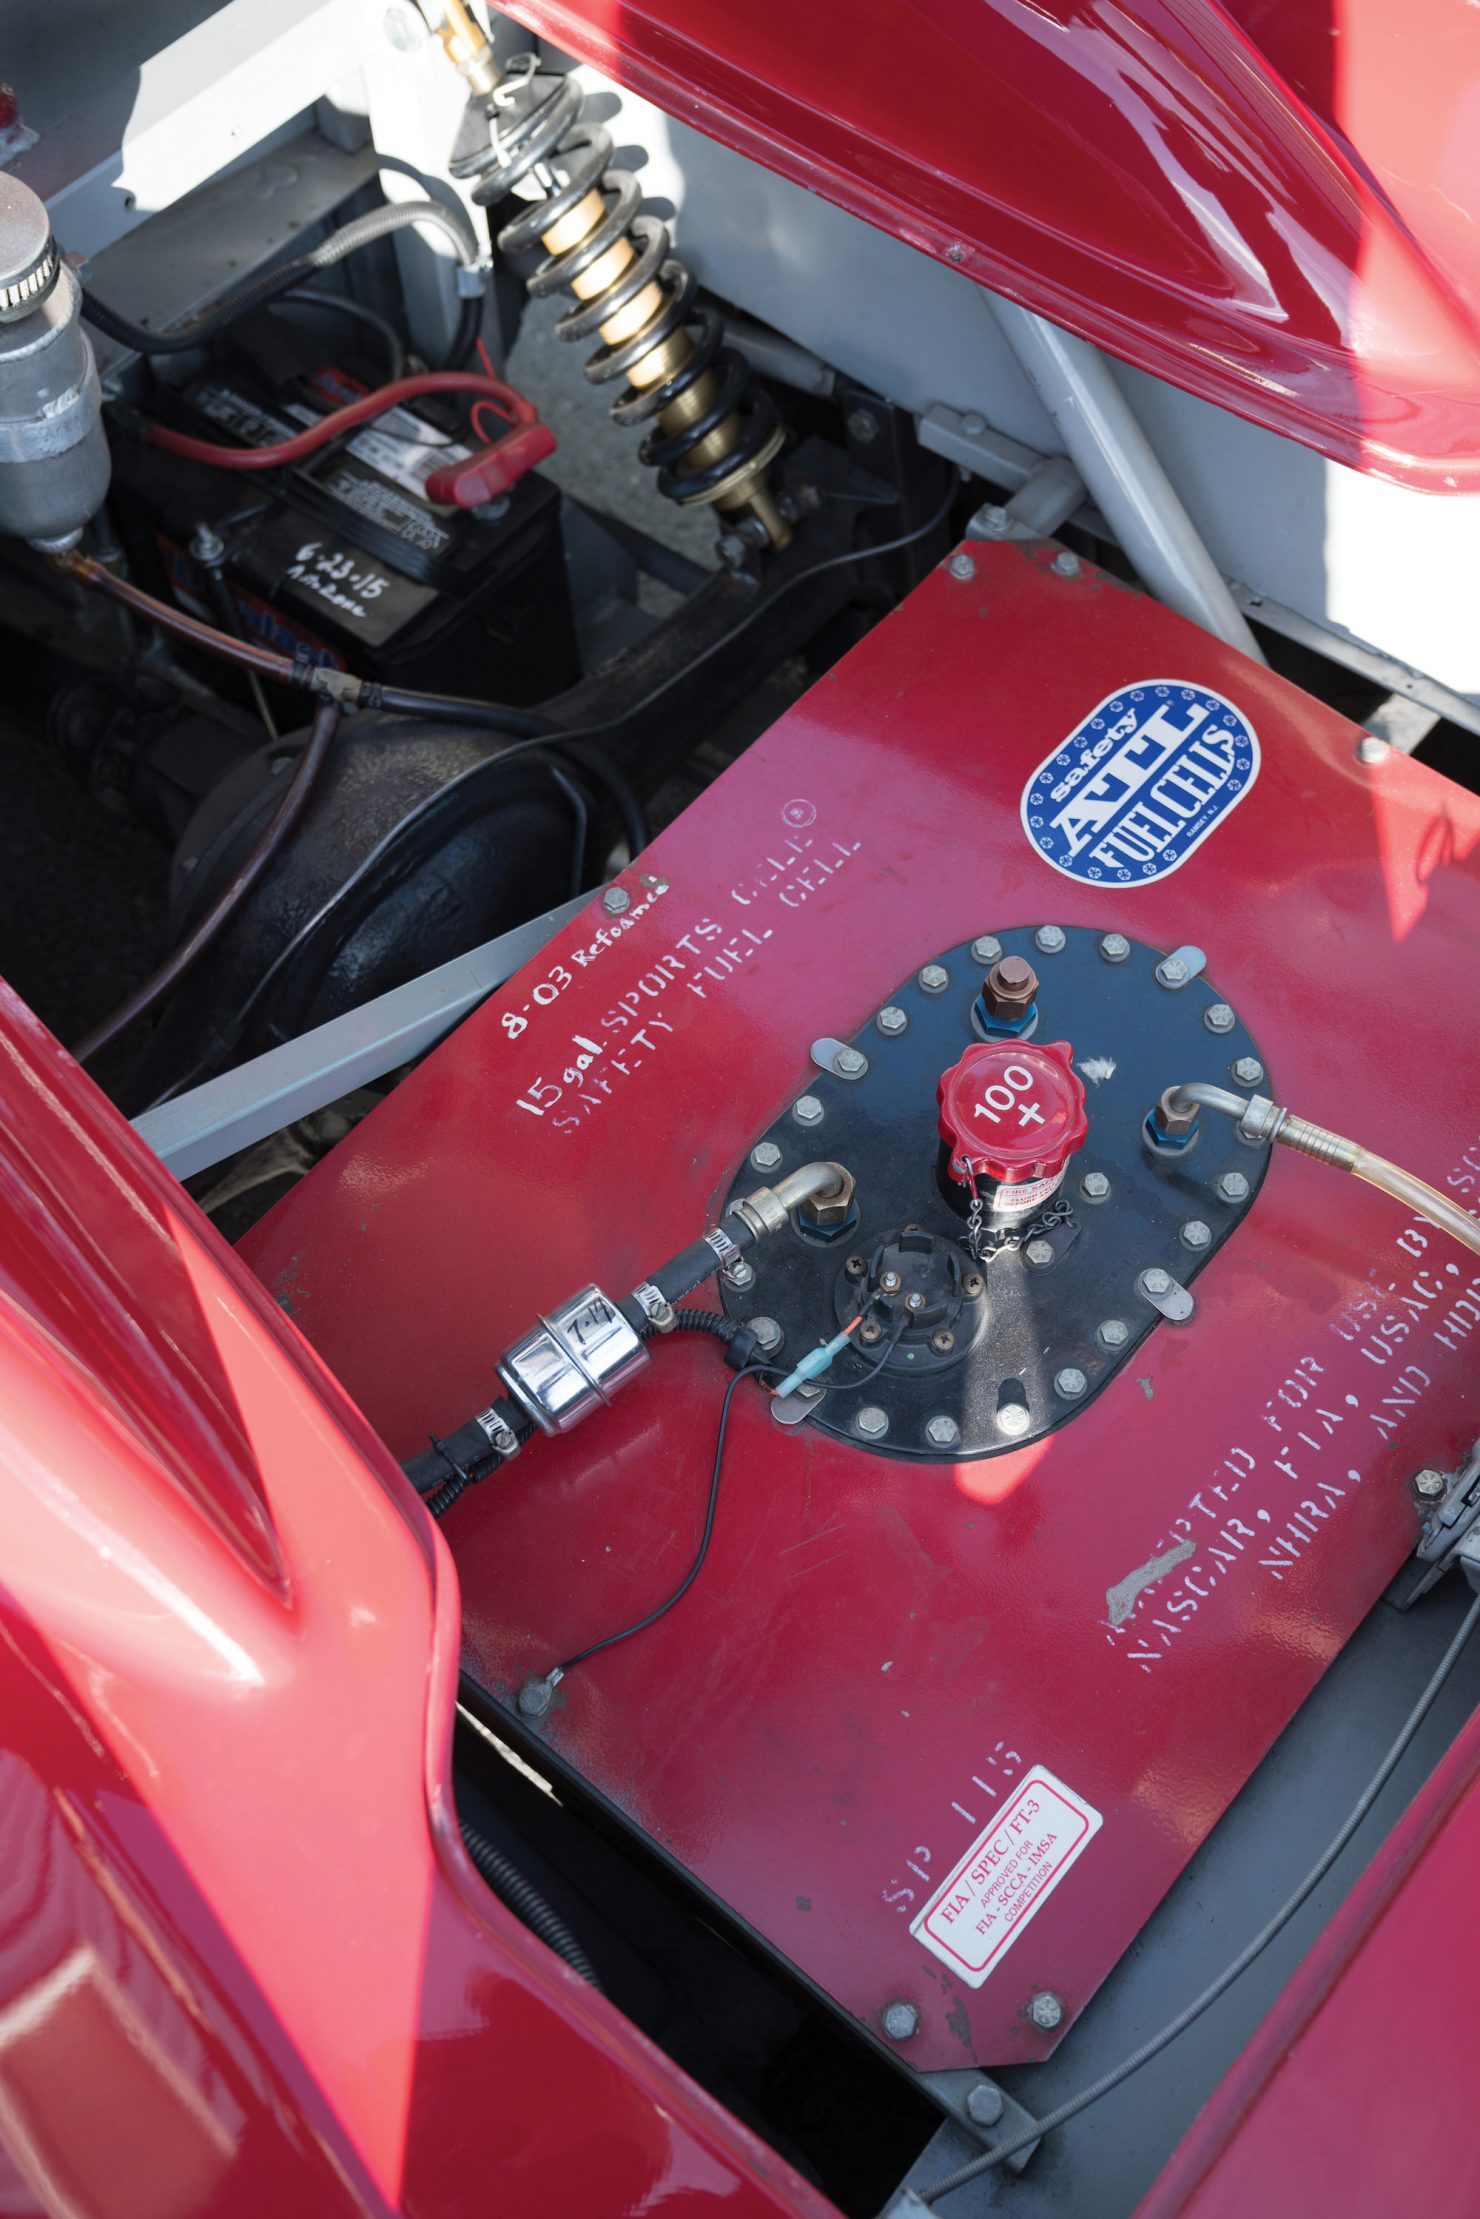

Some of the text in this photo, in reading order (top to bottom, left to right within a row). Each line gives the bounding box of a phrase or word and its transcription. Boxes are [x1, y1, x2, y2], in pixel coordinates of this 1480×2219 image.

[1049, 703, 1211, 858] ATL
[1050, 707, 1138, 802] safety
[1089, 724, 1236, 868] FUEL CELLS
[552, 841, 862, 1134] SAFETY FUEL CELL
[600, 918, 723, 1034] SPORTS
[515, 1076, 563, 1116] 15
[973, 1065, 1034, 1124] 100
[1261, 1356, 1325, 1432] FOR
[1126, 1509, 1272, 1674] NASCAR,
[1360, 1262, 1461, 1365] USAC,
[1258, 1469, 1362, 1580] NHRA,
[1369, 1365, 1431, 1441] AND
[881, 1845, 932, 1913] SP
[939, 1892, 970, 1924] FIA
[970, 1838, 1010, 1886] SPEC
[1009, 1798, 1041, 1836] FT-3
[975, 1911, 998, 1936] FIA
[999, 1871, 1028, 1908] SCCA
[1031, 1831, 1059, 1871] IMSA
[979, 1839, 1034, 1908] APPROVED FOR
[1004, 1861, 1053, 1922] COMPETITION
